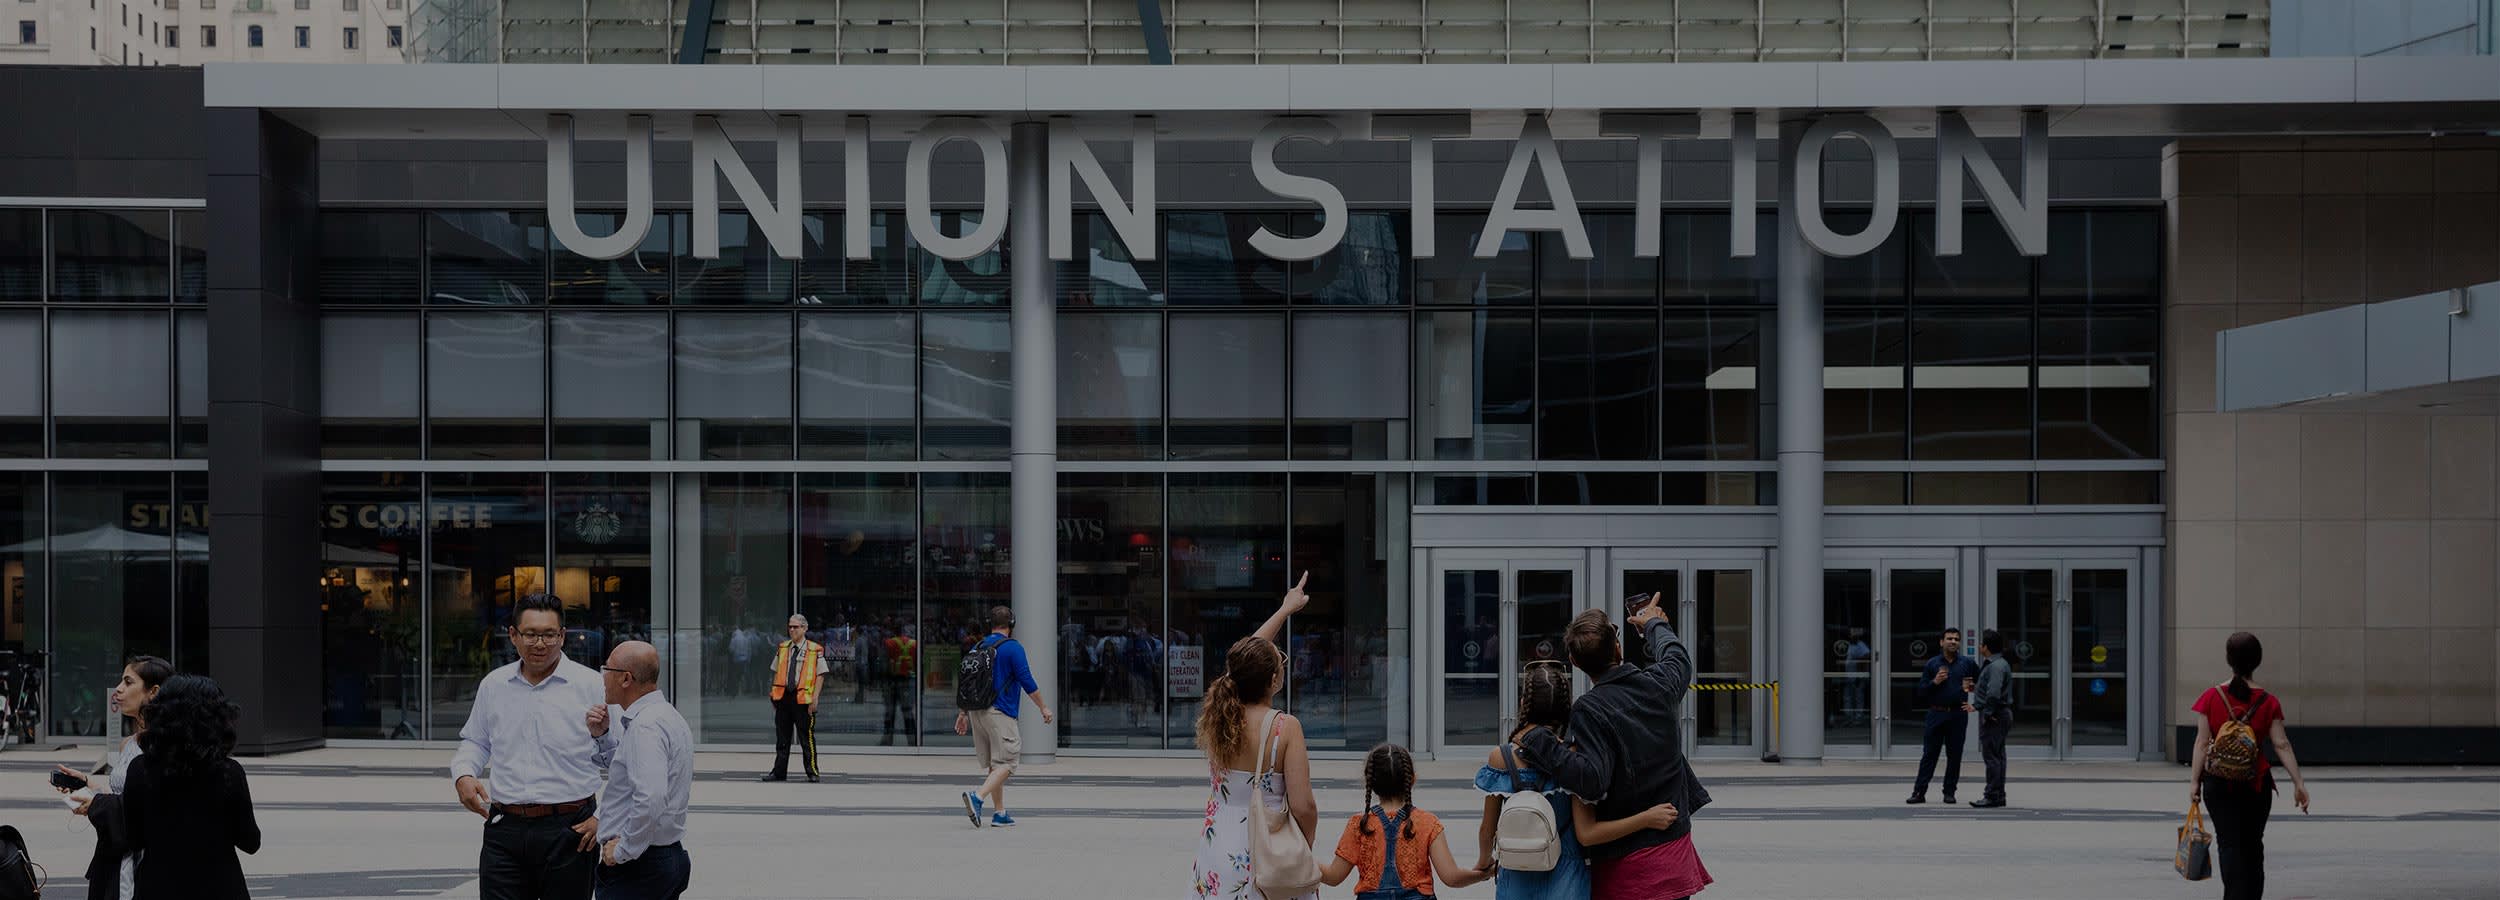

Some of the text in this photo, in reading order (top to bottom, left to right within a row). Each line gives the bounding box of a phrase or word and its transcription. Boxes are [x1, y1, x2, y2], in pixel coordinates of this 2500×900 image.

[547, 111, 2049, 262] UNION STATION
[357, 503, 493, 529] COFFEE
[1180, 650, 1200, 660] CLEAN
[1169, 666, 1200, 676] LTERATION
